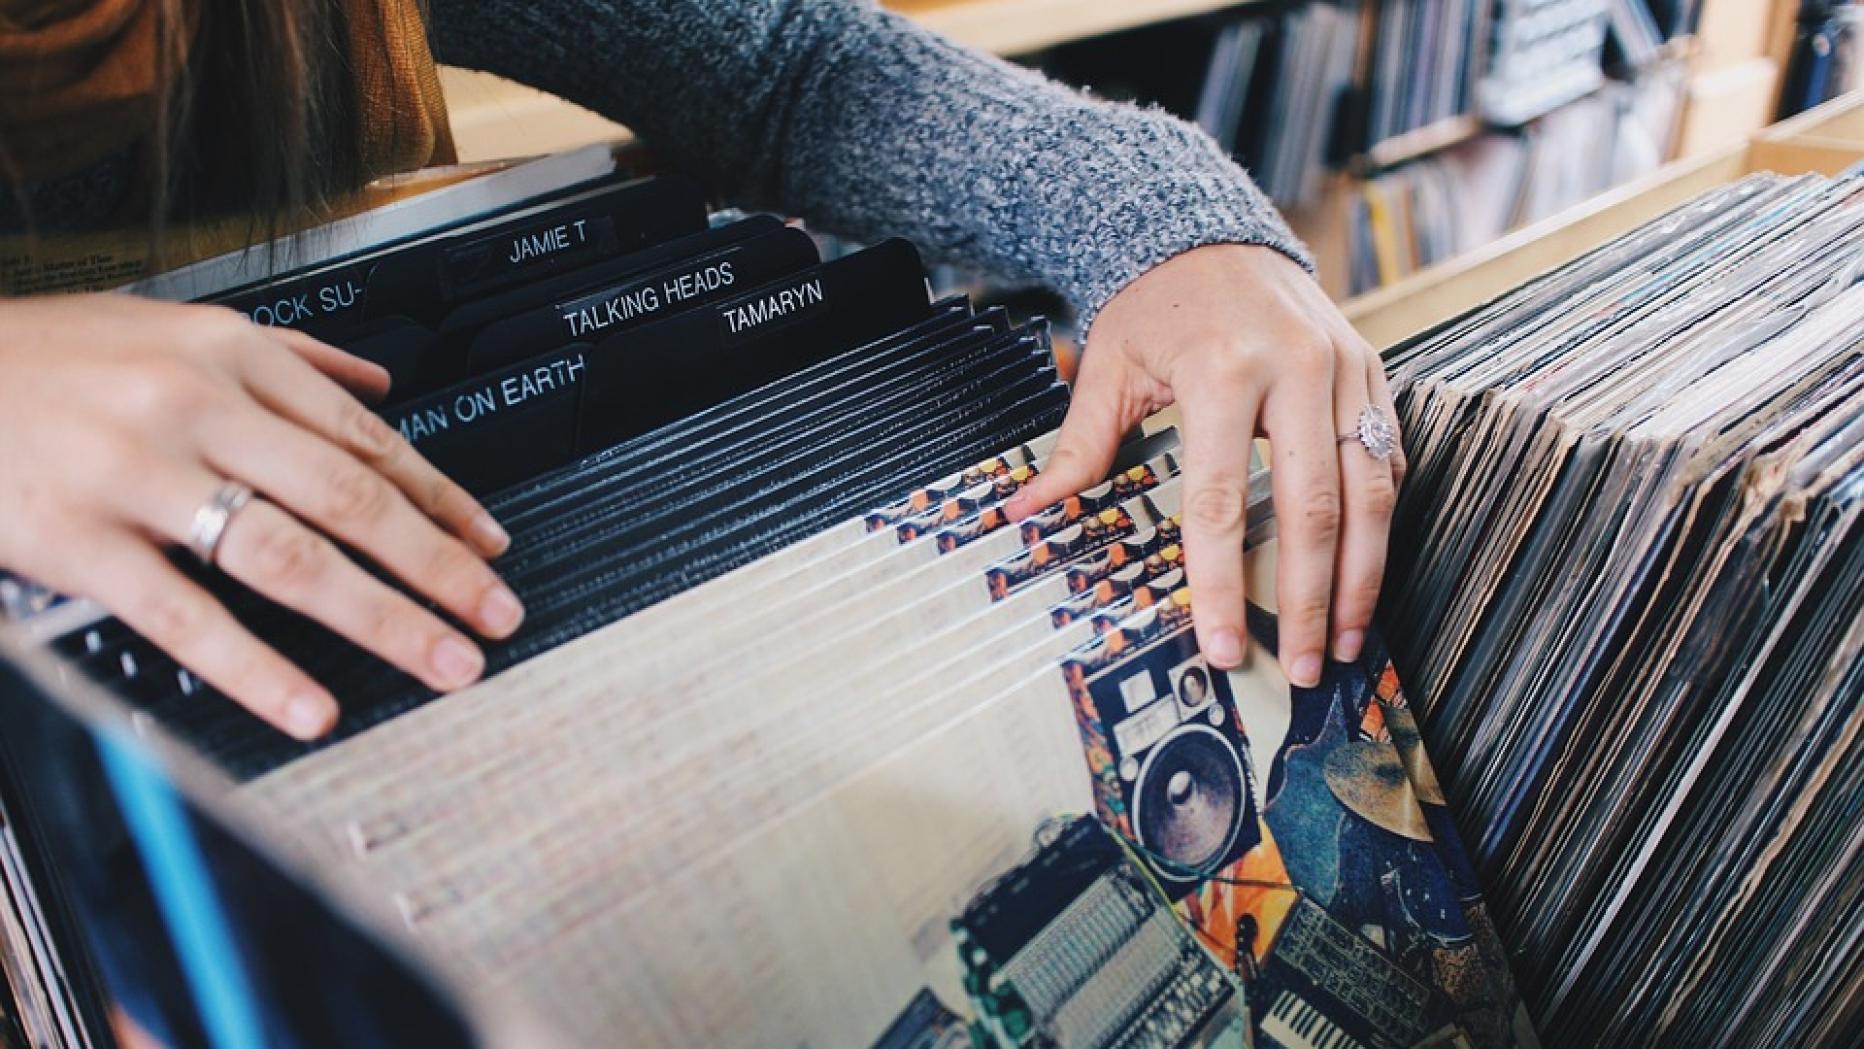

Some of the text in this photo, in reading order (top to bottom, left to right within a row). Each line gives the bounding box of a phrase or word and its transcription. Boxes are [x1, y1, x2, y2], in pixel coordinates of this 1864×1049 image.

[509, 218, 588, 264] JAMIE T
[252, 280, 363, 327] OCK SU-
[562, 261, 736, 338] TALKING HEADS
[722, 279, 824, 334] TAMARYN
[454, 385, 497, 423] ON
[500, 352, 587, 407] EARTH
